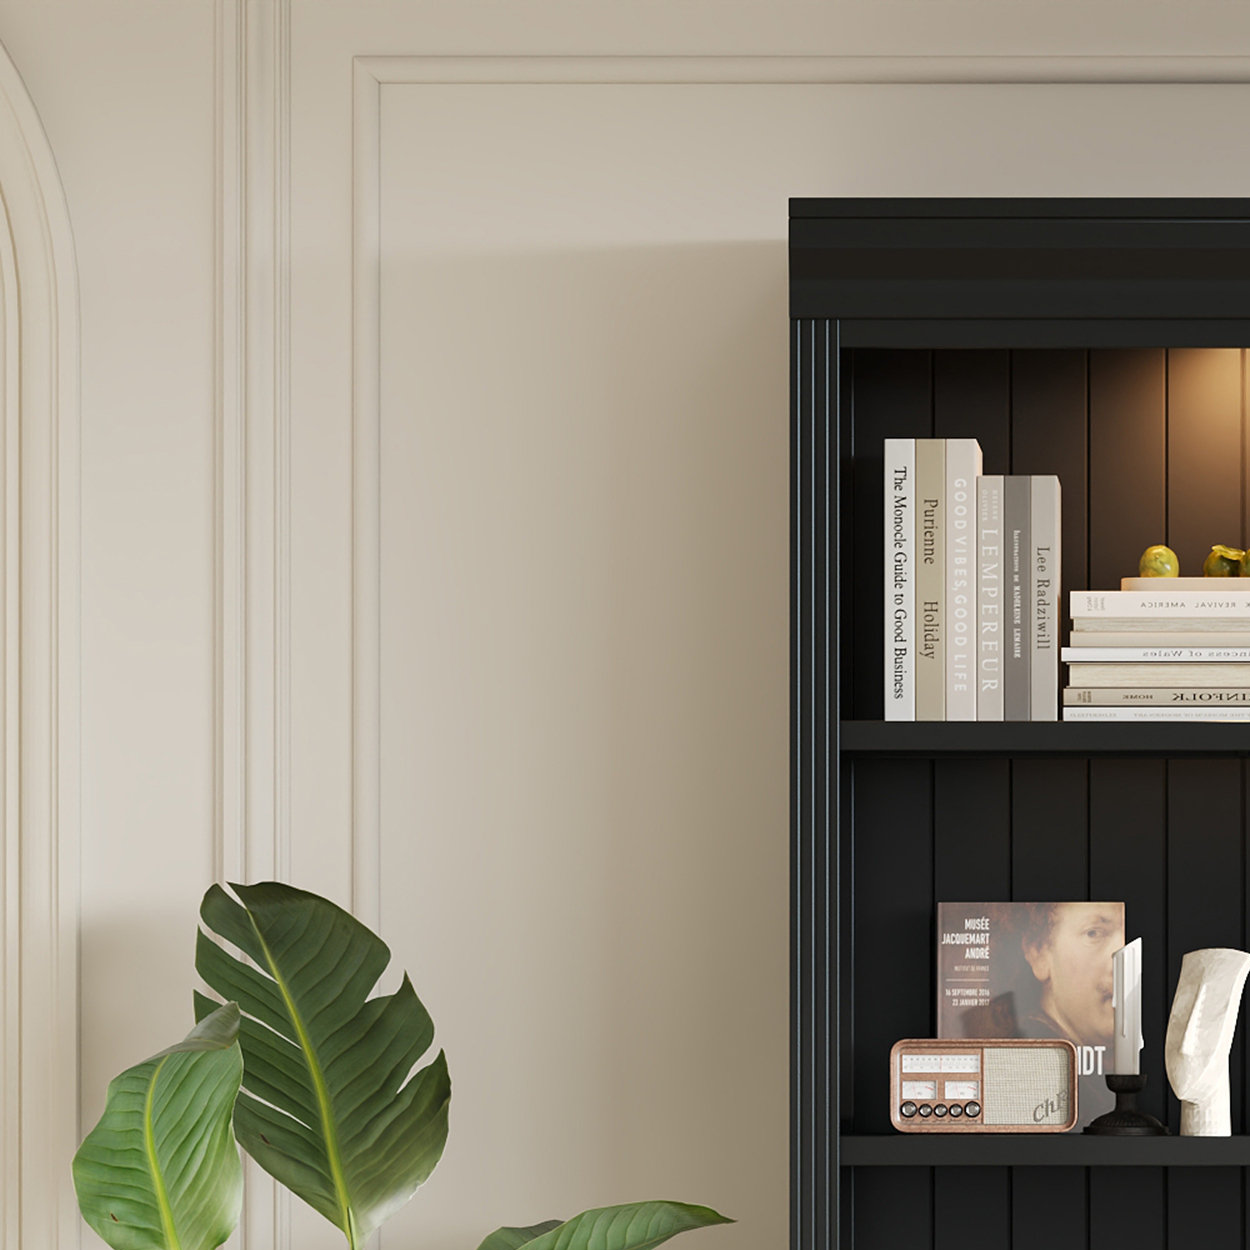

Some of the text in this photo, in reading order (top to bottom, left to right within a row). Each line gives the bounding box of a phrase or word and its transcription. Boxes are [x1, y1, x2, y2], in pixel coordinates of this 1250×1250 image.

[955, 478, 967, 530] GOOD
[924, 500, 938, 565] Purienne
[894, 466, 907, 699] The Monocle Guide to Good Business
[1037, 547, 1050, 649] Lee Radziwill
[919, 601, 939, 659] Holiday
[955, 595, 968, 646] GOOD
[982, 529, 998, 692] LEMPEREUR
[955, 654, 967, 691] LIFE
[941, 933, 990, 945] JACQUEMART
[964, 916, 990, 930] MUSÉE
[964, 946, 990, 959] ANDRÉ
